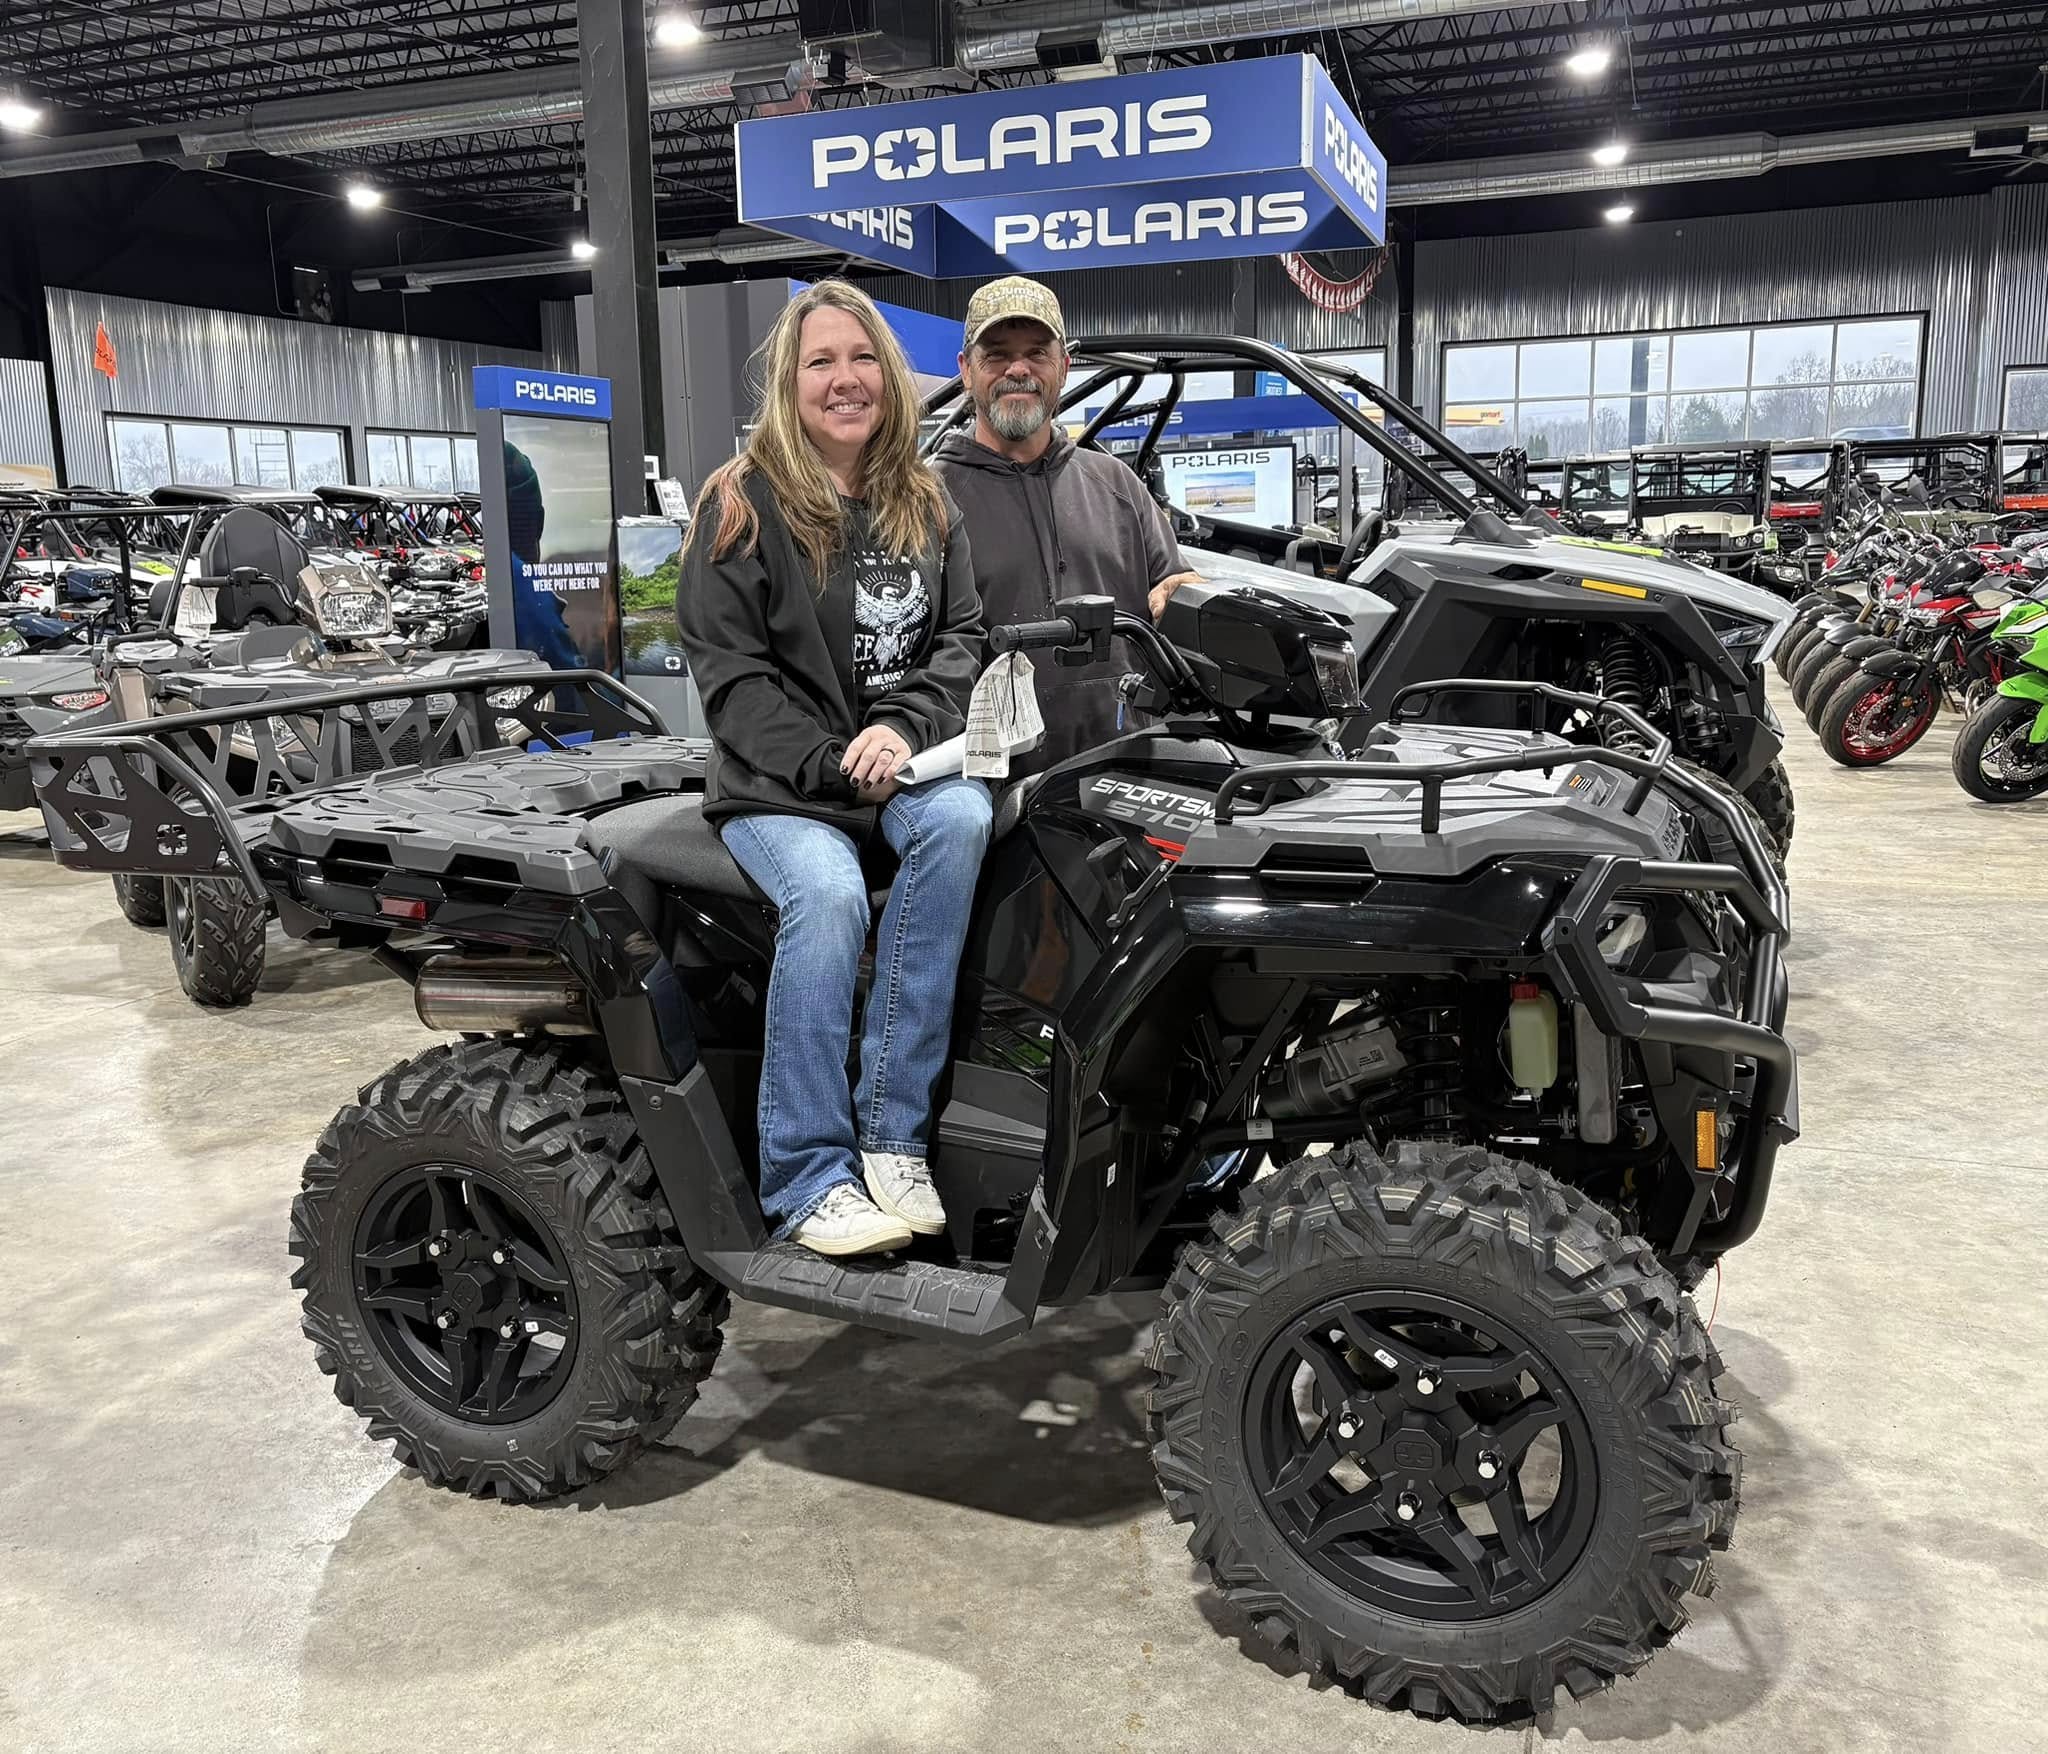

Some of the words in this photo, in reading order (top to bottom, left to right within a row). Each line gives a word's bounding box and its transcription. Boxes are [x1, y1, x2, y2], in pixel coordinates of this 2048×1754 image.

[812, 94, 1212, 188] POLARIS
[1324, 101, 1378, 213] POLARIS
[808, 206, 914, 250] LARIS
[994, 191, 1309, 255] POLARIS
[515, 380, 597, 406] POLARIS
[1172, 451, 1271, 469] POLARIS
[522, 564, 532, 577] SO
[533, 563, 548, 577] YOU
[549, 562, 563, 576] CAN
[564, 562, 574, 575] DO
[574, 562, 593, 575] WHAT
[595, 561, 608, 574] YOU
[533, 578, 553, 592] WERE
[554, 578, 568, 591] PUT
[569, 577, 586, 590] HERE
[587, 576, 600, 589] FOR
[1090, 777, 1216, 819] SPORTSM
[1105, 800, 1201, 833] 570
